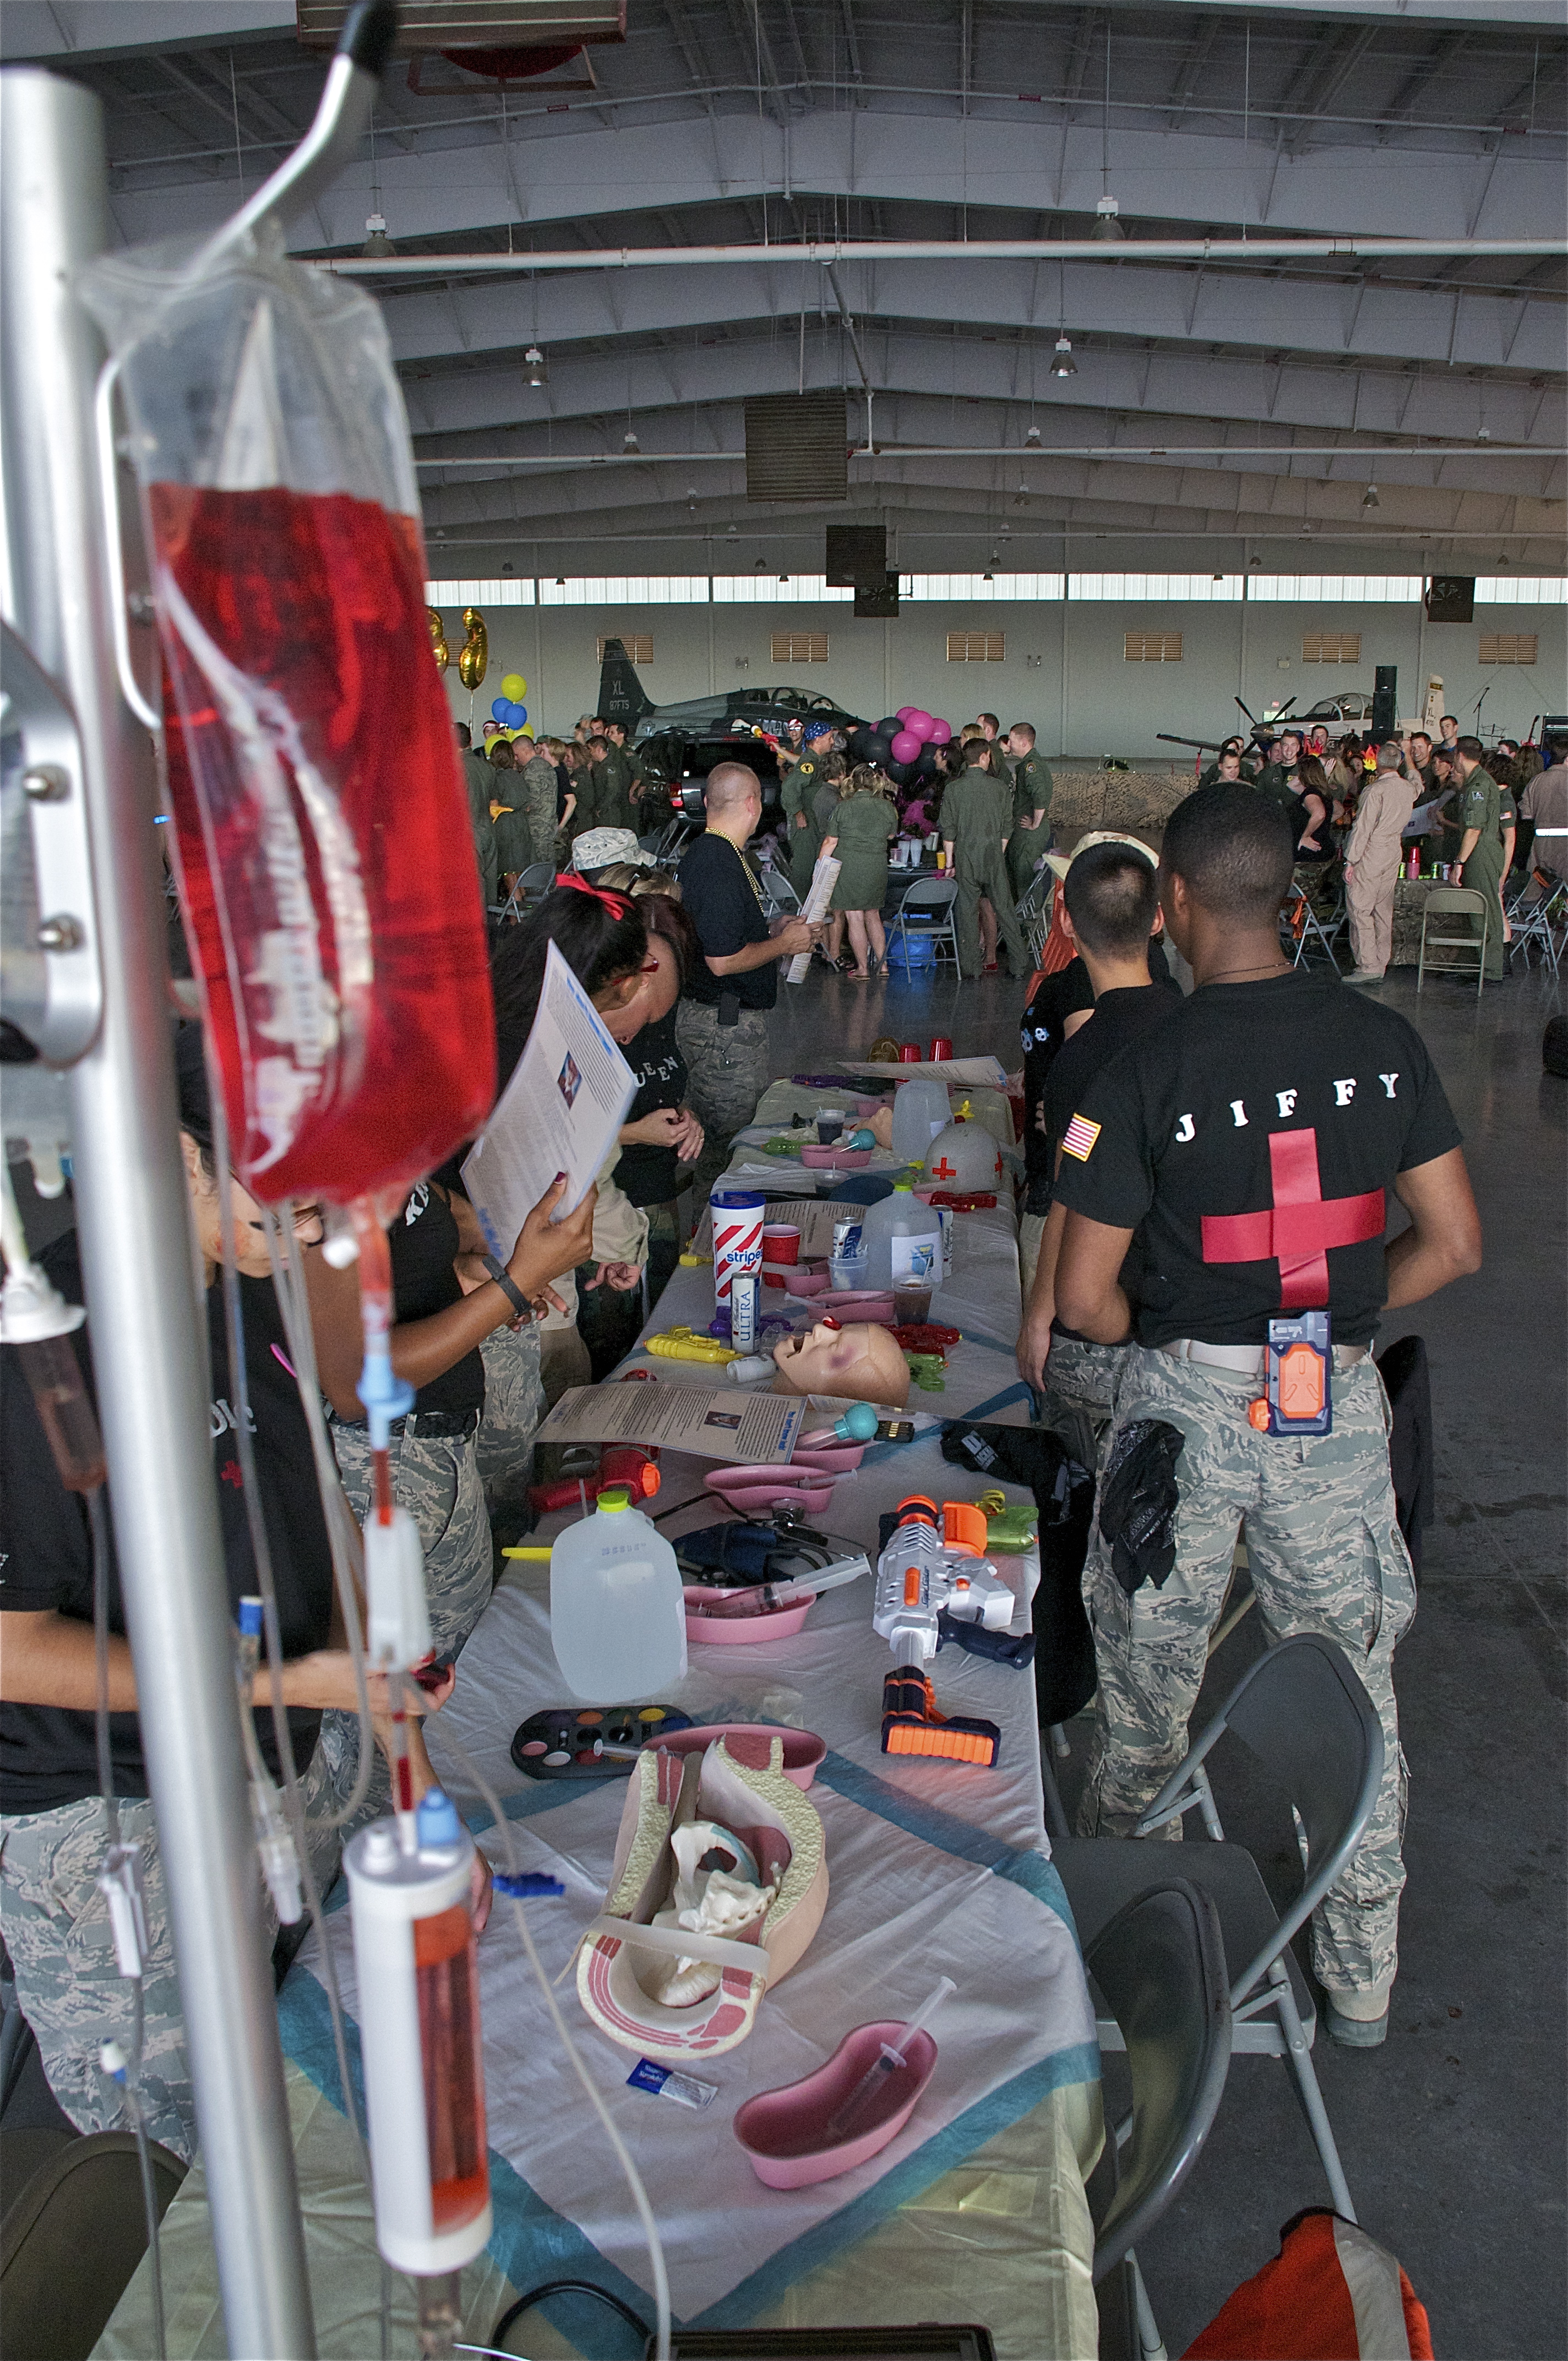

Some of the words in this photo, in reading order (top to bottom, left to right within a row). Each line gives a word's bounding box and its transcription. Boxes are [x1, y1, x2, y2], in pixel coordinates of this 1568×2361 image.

[613, 680, 625, 695] XL
[609, 700, 629, 710] 87FTS
[634, 1056, 679, 1087] UEEN
[1175, 1073, 1400, 1143] JIFFY
[741, 1291, 750, 1342] ULTRA
